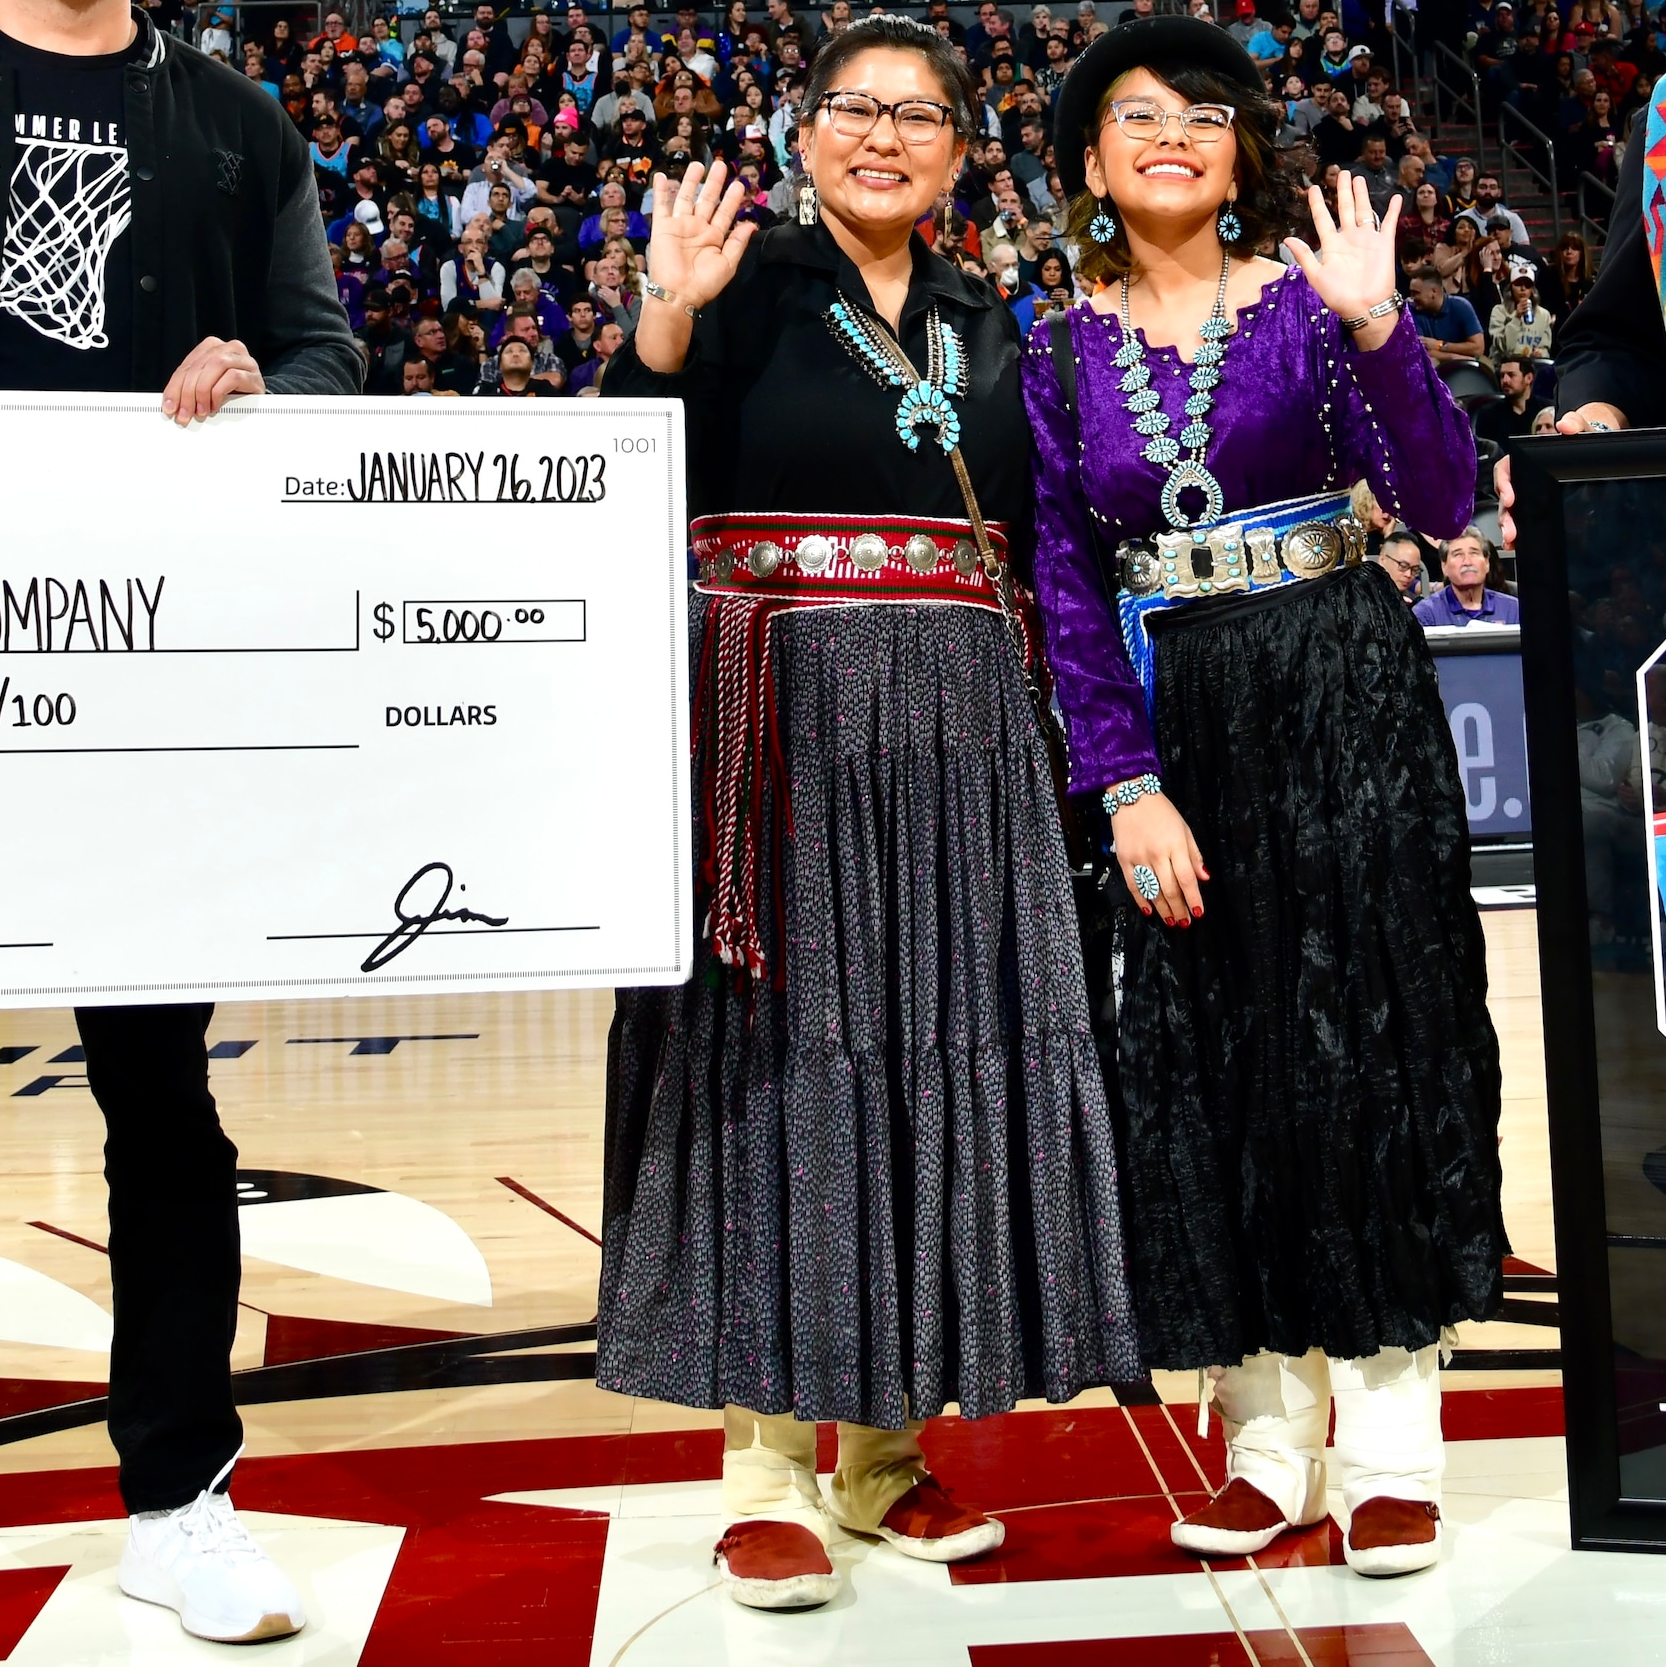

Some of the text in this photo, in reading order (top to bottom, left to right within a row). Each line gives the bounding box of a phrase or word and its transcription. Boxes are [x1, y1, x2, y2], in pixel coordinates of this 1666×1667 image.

[612, 437, 657, 455] 1001
[283, 474, 346, 498] Date:
[347, 450, 485, 504] JANUARY
[373, 601, 395, 643] $
[384, 704, 498, 728] DOLLARS
